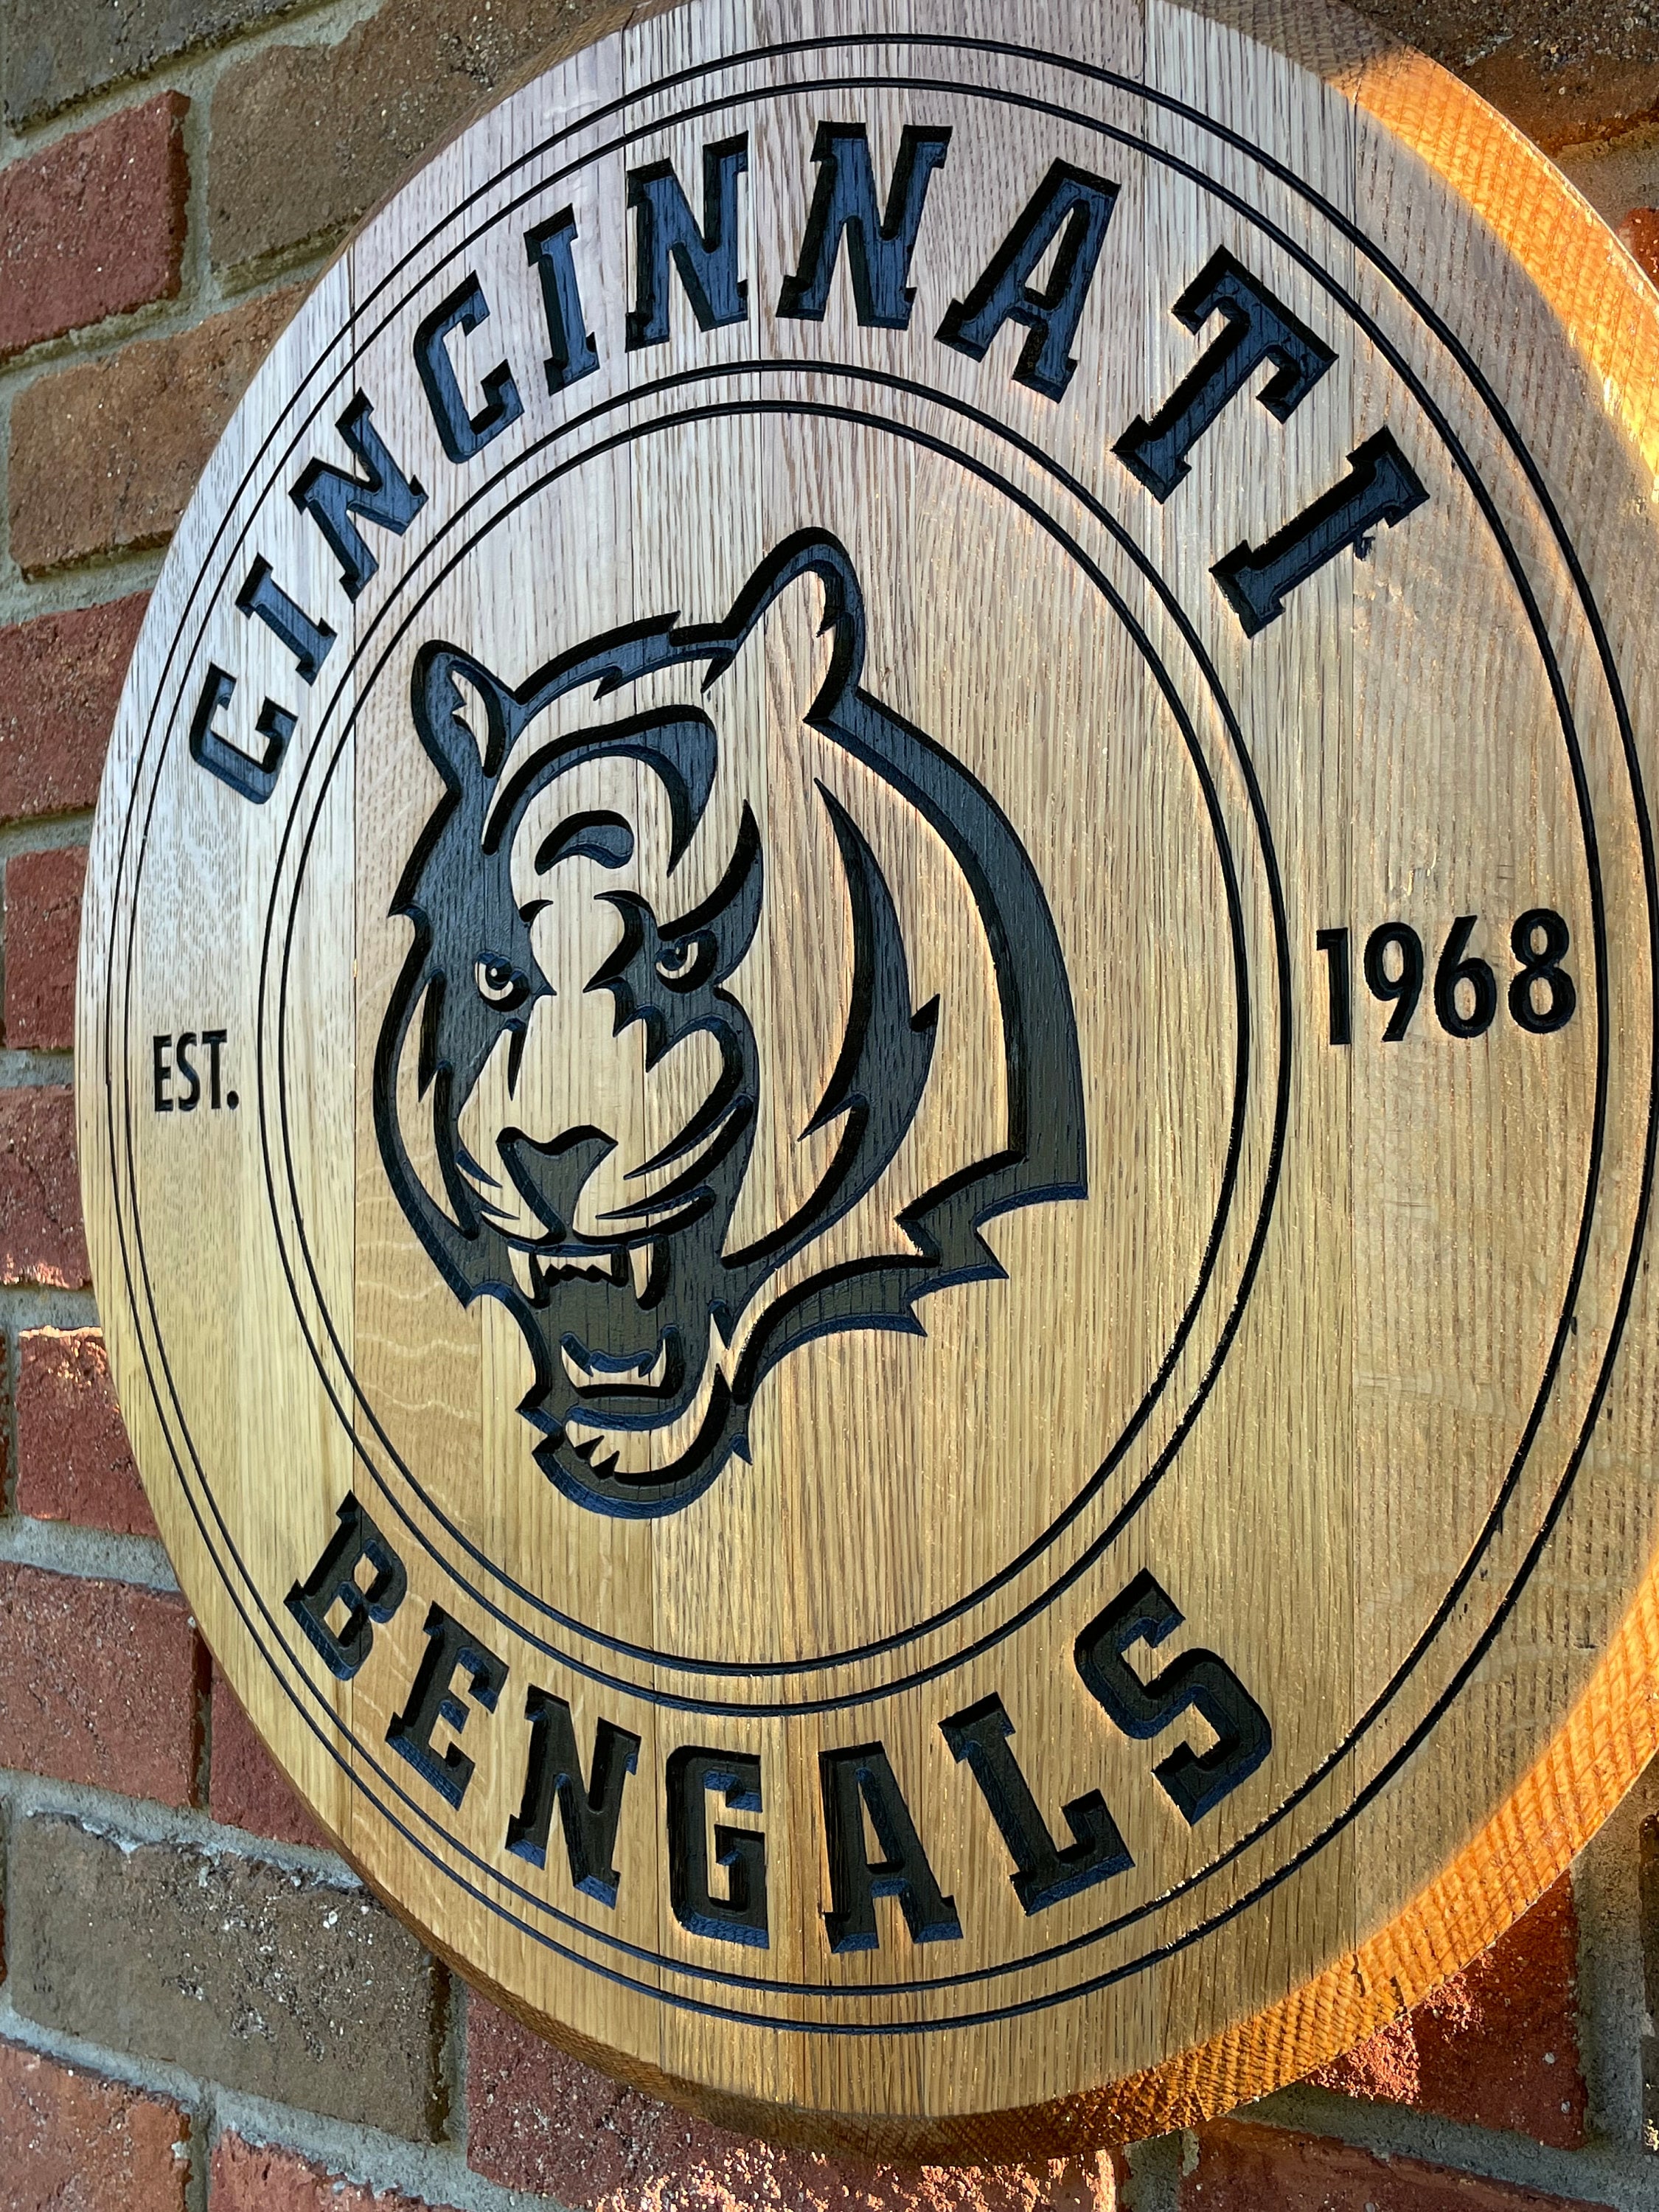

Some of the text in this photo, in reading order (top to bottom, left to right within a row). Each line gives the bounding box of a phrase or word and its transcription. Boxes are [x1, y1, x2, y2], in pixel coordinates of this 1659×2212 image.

[189, 119, 1430, 804] CINCINNATI
[153, 908, 1577, 1112] EST. 1968
[283, 1491, 1272, 1954] BENGALS
